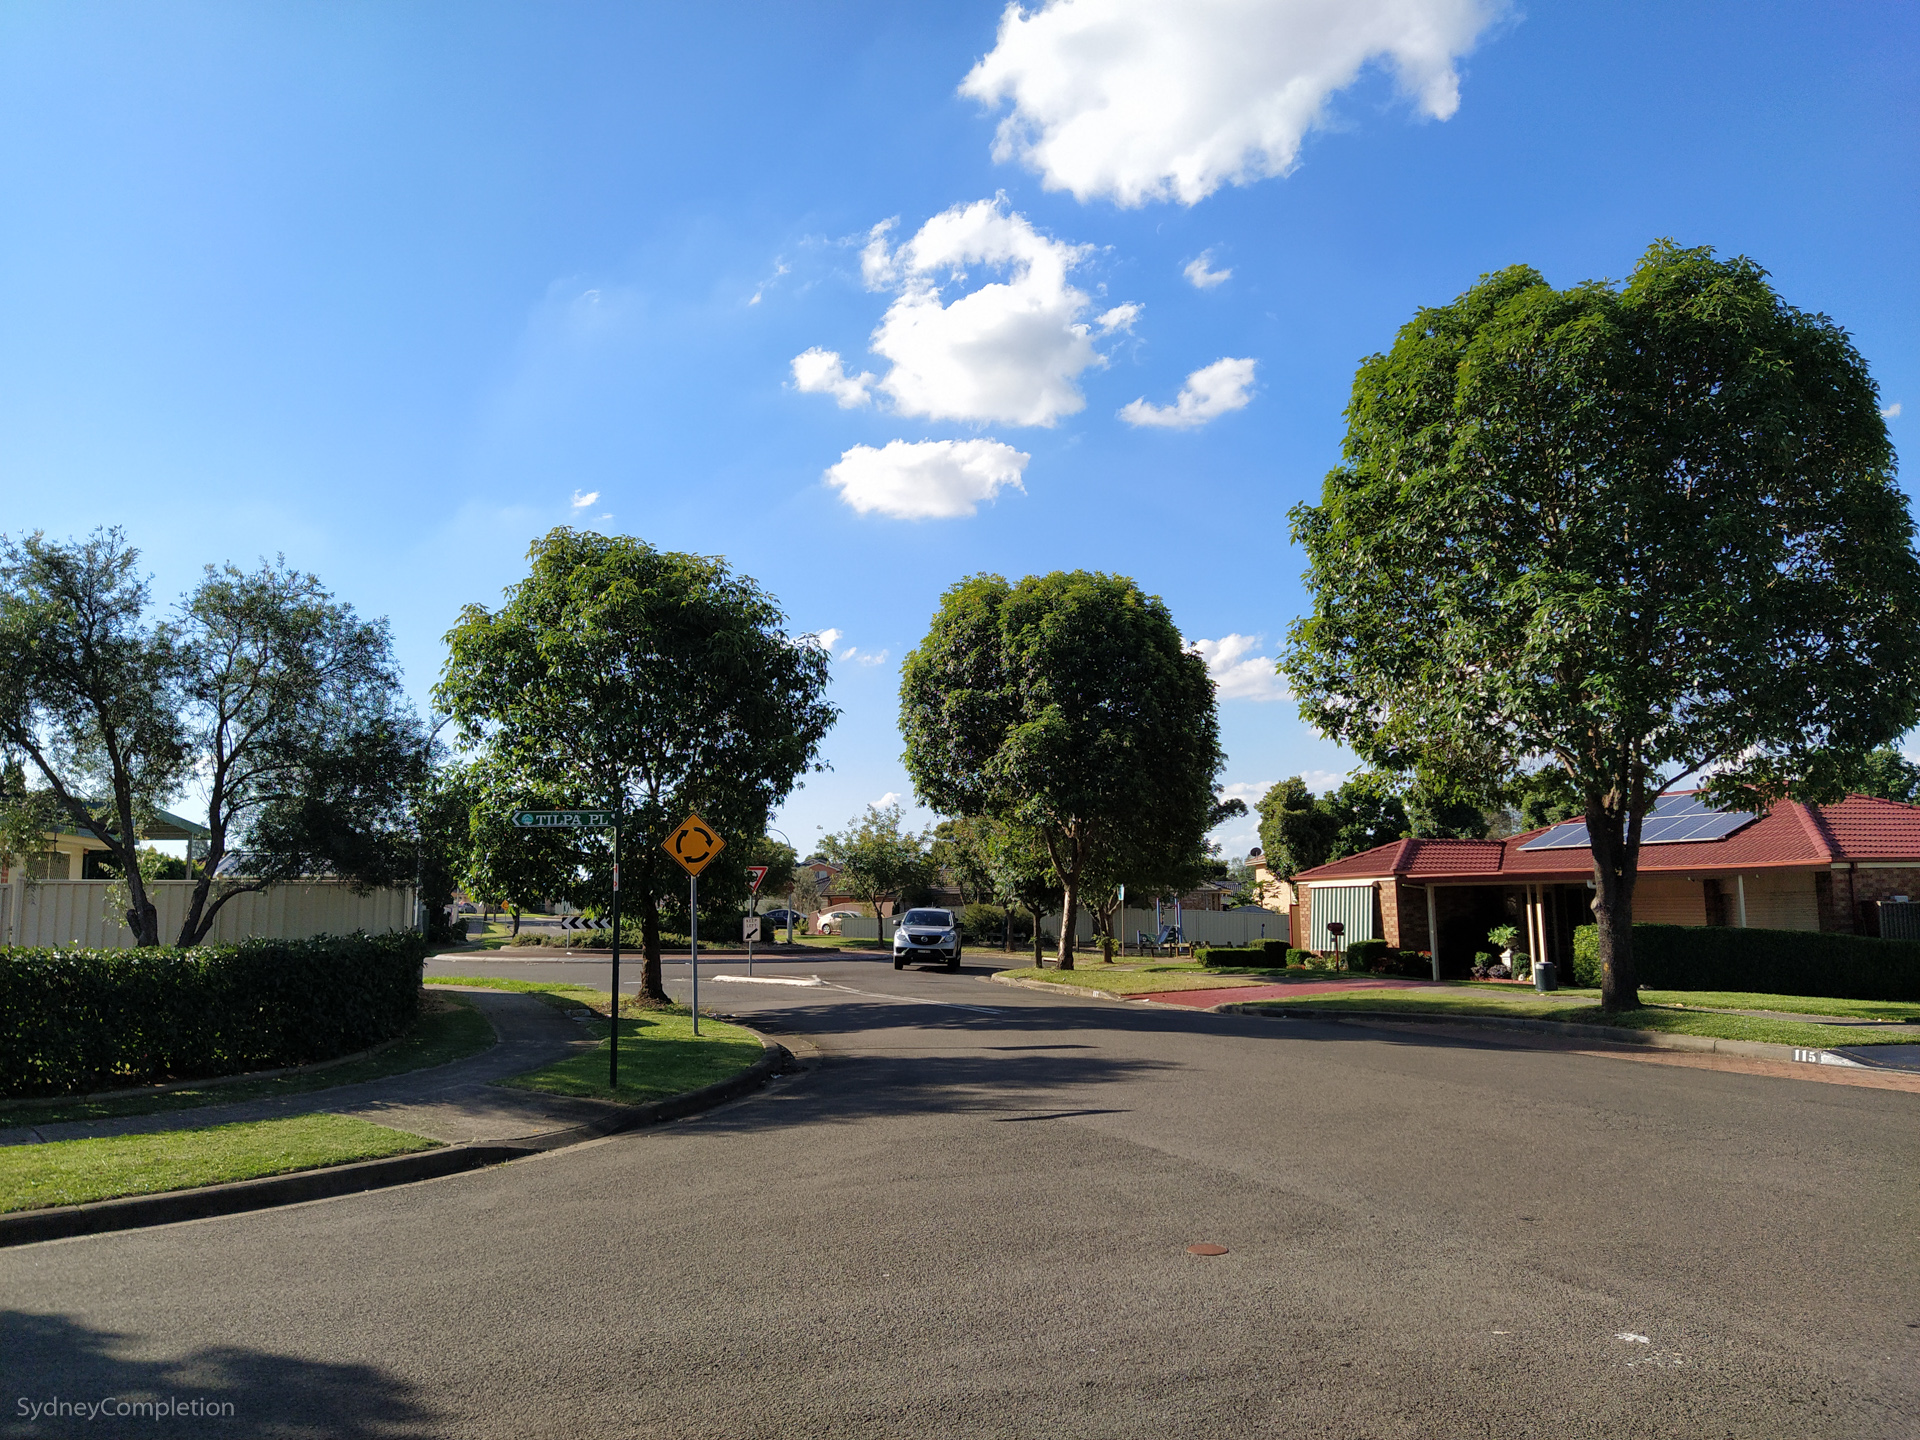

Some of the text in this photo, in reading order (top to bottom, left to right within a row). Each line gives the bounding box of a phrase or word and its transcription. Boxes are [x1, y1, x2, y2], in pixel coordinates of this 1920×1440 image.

[536, 814, 609, 826] TILPA PL
[1794, 1049, 1816, 1063] 115
